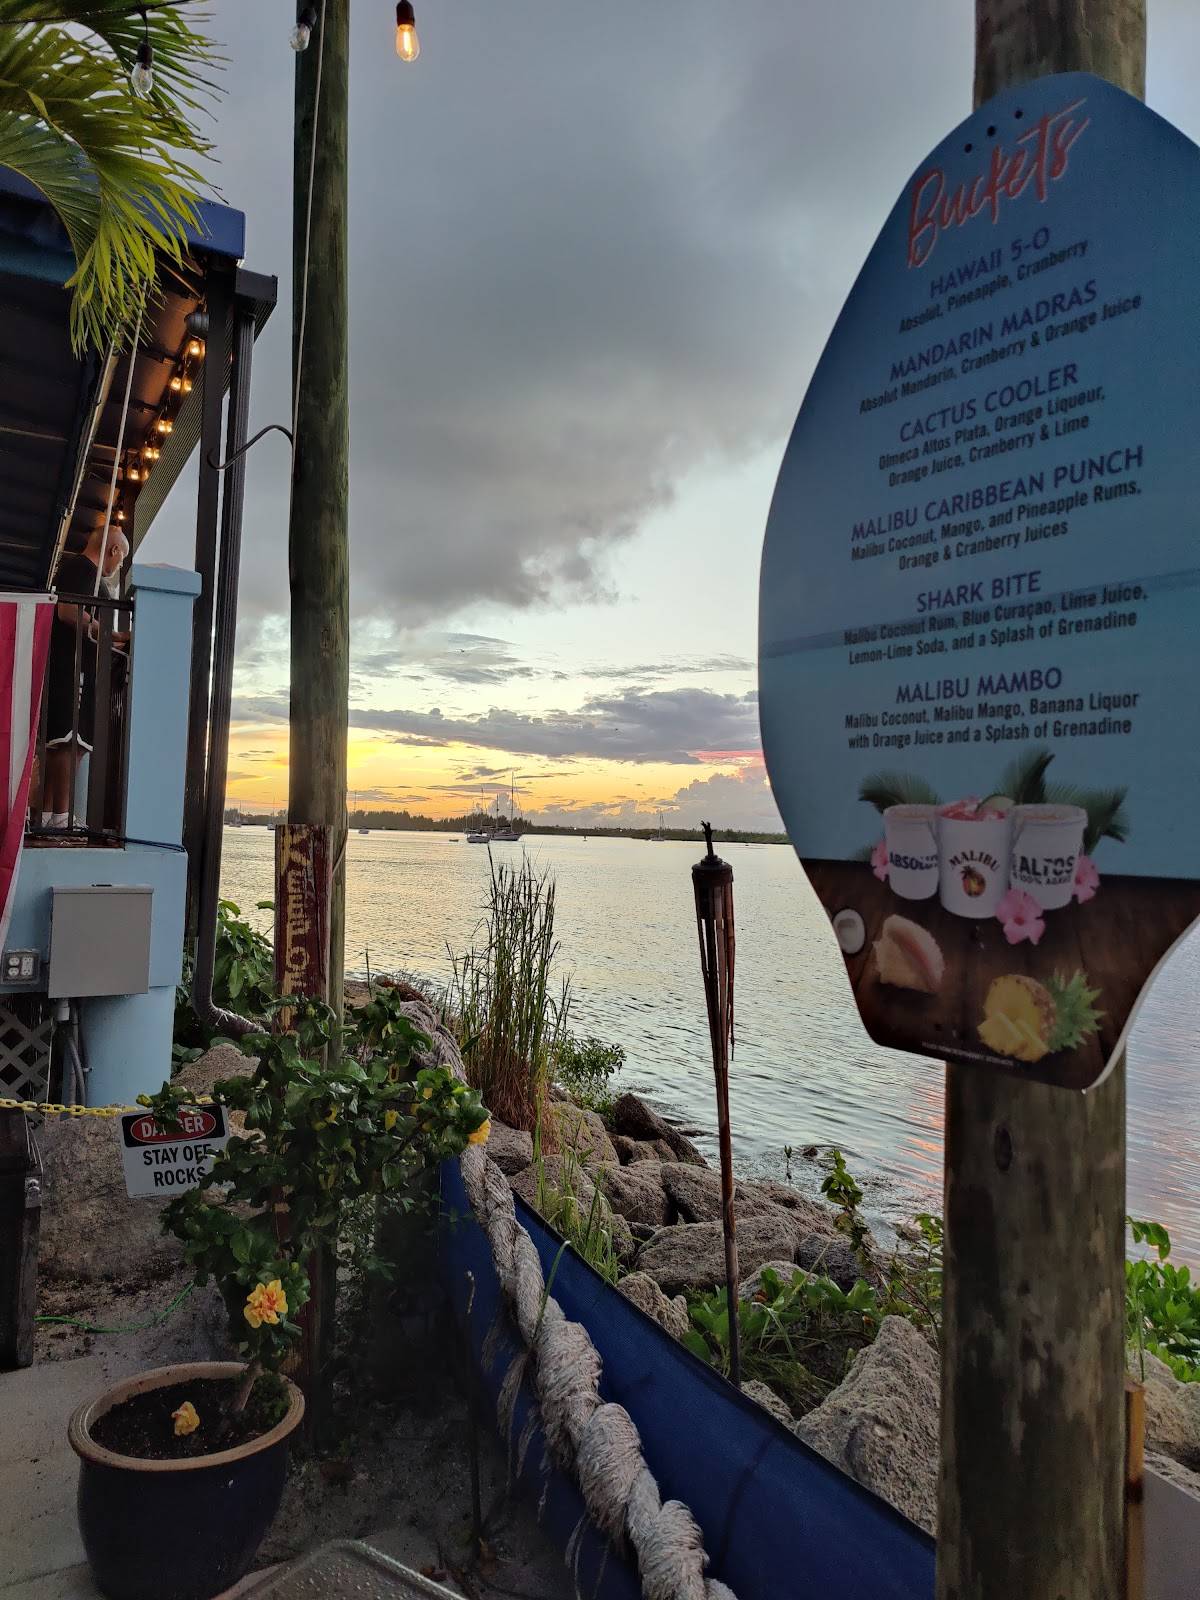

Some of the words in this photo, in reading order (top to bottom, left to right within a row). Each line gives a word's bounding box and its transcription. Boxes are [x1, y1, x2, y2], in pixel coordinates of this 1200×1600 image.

[930, 247, 1001, 298] HAWAII
[1017, 240, 1089, 281] Cranberry
[890, 323, 993, 380] MANDARIN
[1001, 279, 1097, 337] MADRAS
[860, 387, 898, 415] Absolut
[961, 338, 1025, 374] Cranberry
[1030, 330, 1040, 347] &
[1046, 310, 1096, 342] Orange
[1101, 295, 1142, 321] Juice
[900, 399, 976, 443] CACTUS
[984, 363, 1078, 413] COOLER
[879, 447, 919, 470] Olmeca
[923, 438, 950, 456] Altos
[995, 407, 1043, 433] Orange
[889, 466, 928, 487] Orange
[969, 431, 1035, 462] Cranberry
[1040, 424, 1049, 441] &
[1054, 415, 1089, 437] Lime
[852, 507, 918, 541] MALIBU
[925, 472, 1044, 522] CARIBBEAN
[1053, 445, 1144, 488] PUNCH
[851, 541, 885, 561] Malibu
[988, 509, 1012, 528] and
[1017, 491, 1088, 521] Pineapple
[899, 551, 939, 570] Orange
[943, 545, 951, 559] &
[956, 532, 1020, 558] Cranberry
[1024, 521, 1068, 542] Juices
[917, 582, 983, 613] SHARK
[992, 571, 1041, 598] BITE
[844, 625, 877, 645] Malibu
[880, 617, 925, 638] Coconut
[962, 606, 990, 626] Blue
[1061, 589, 1096, 609] Lime
[849, 642, 912, 665] Lemon-Lime
[952, 633, 974, 650] and
[979, 635, 986, 647] a
[990, 622, 1035, 647] Splash
[1039, 620, 1052, 637] of
[1058, 610, 1137, 635] Grenadine
[896, 677, 969, 704] MALIBU
[977, 667, 1062, 696] MAMBO
[845, 713, 878, 729] Malibu
[934, 704, 973, 722] Malibu
[1030, 696, 1084, 714] Banana
[1089, 692, 1140, 711] Liquor
[848, 732, 869, 749] with
[873, 731, 912, 749] Orange
[914, 728, 943, 744] Juice
[947, 726, 969, 743] and
[974, 730, 981, 741] a
[985, 723, 1029, 743] Splash
[1034, 721, 1047, 738] of
[1053, 717, 1132, 738] Grenadine
[889, 852, 938, 870] ABSOL
[949, 850, 999, 871] MALIBU
[1019, 855, 1075, 877] ALTOS
[141, 1116, 205, 1138] DAER
[143, 1147, 179, 1166] STAY
[183, 1144, 211, 1163] OFF
[154, 1167, 206, 1187] ROCKS
